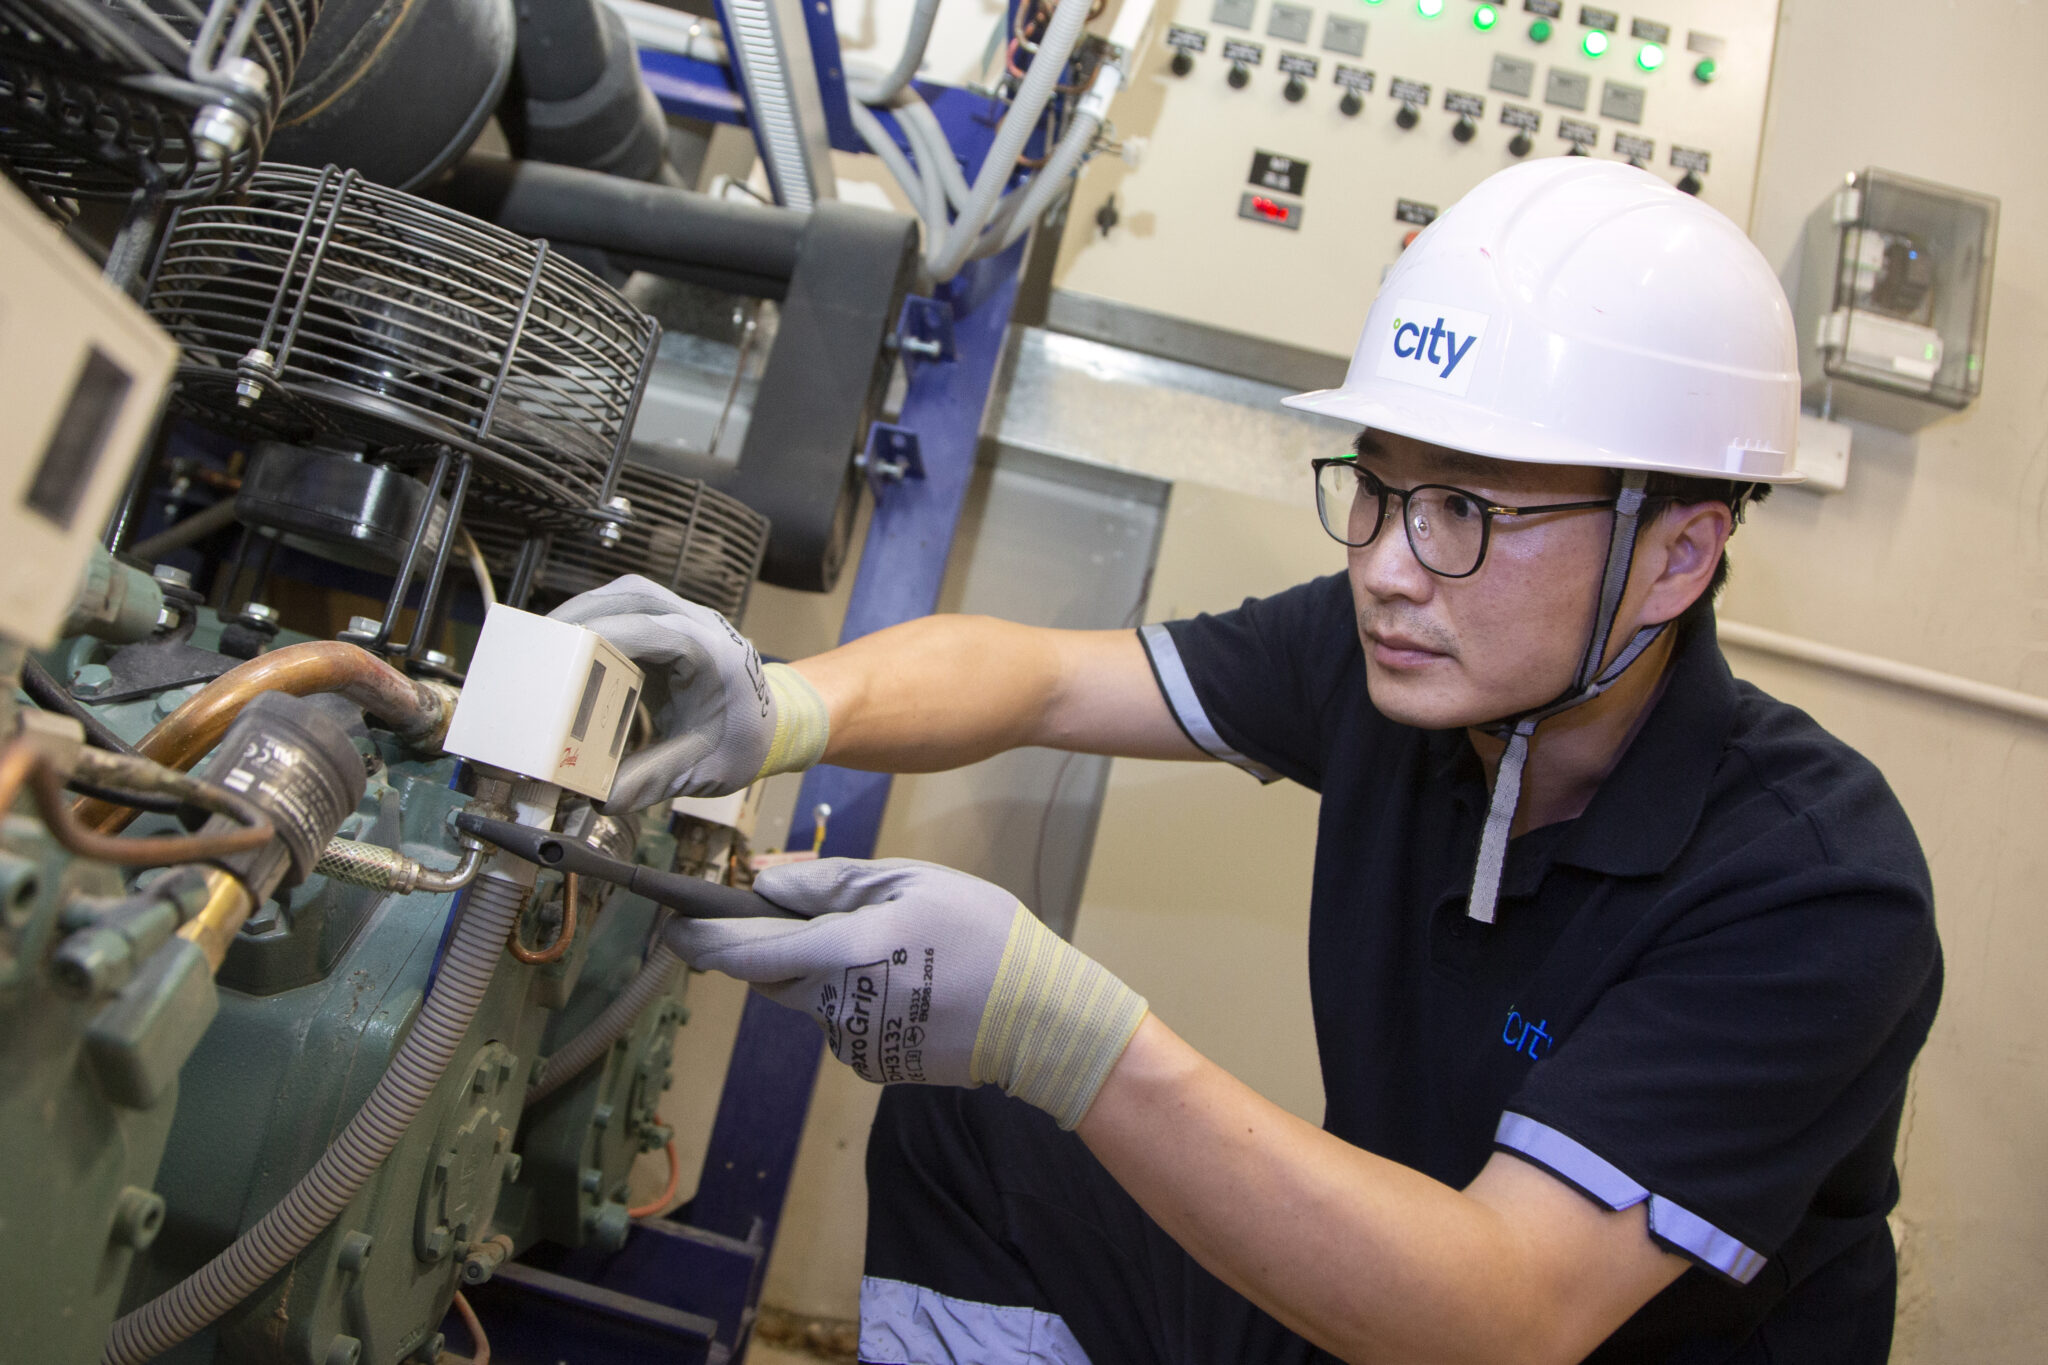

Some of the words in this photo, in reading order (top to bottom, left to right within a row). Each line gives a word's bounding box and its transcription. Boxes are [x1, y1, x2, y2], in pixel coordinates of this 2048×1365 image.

[892, 948, 908, 965] 8
[885, 1017, 905, 1082] DH3132
[1502, 1009, 1554, 1062] cit
